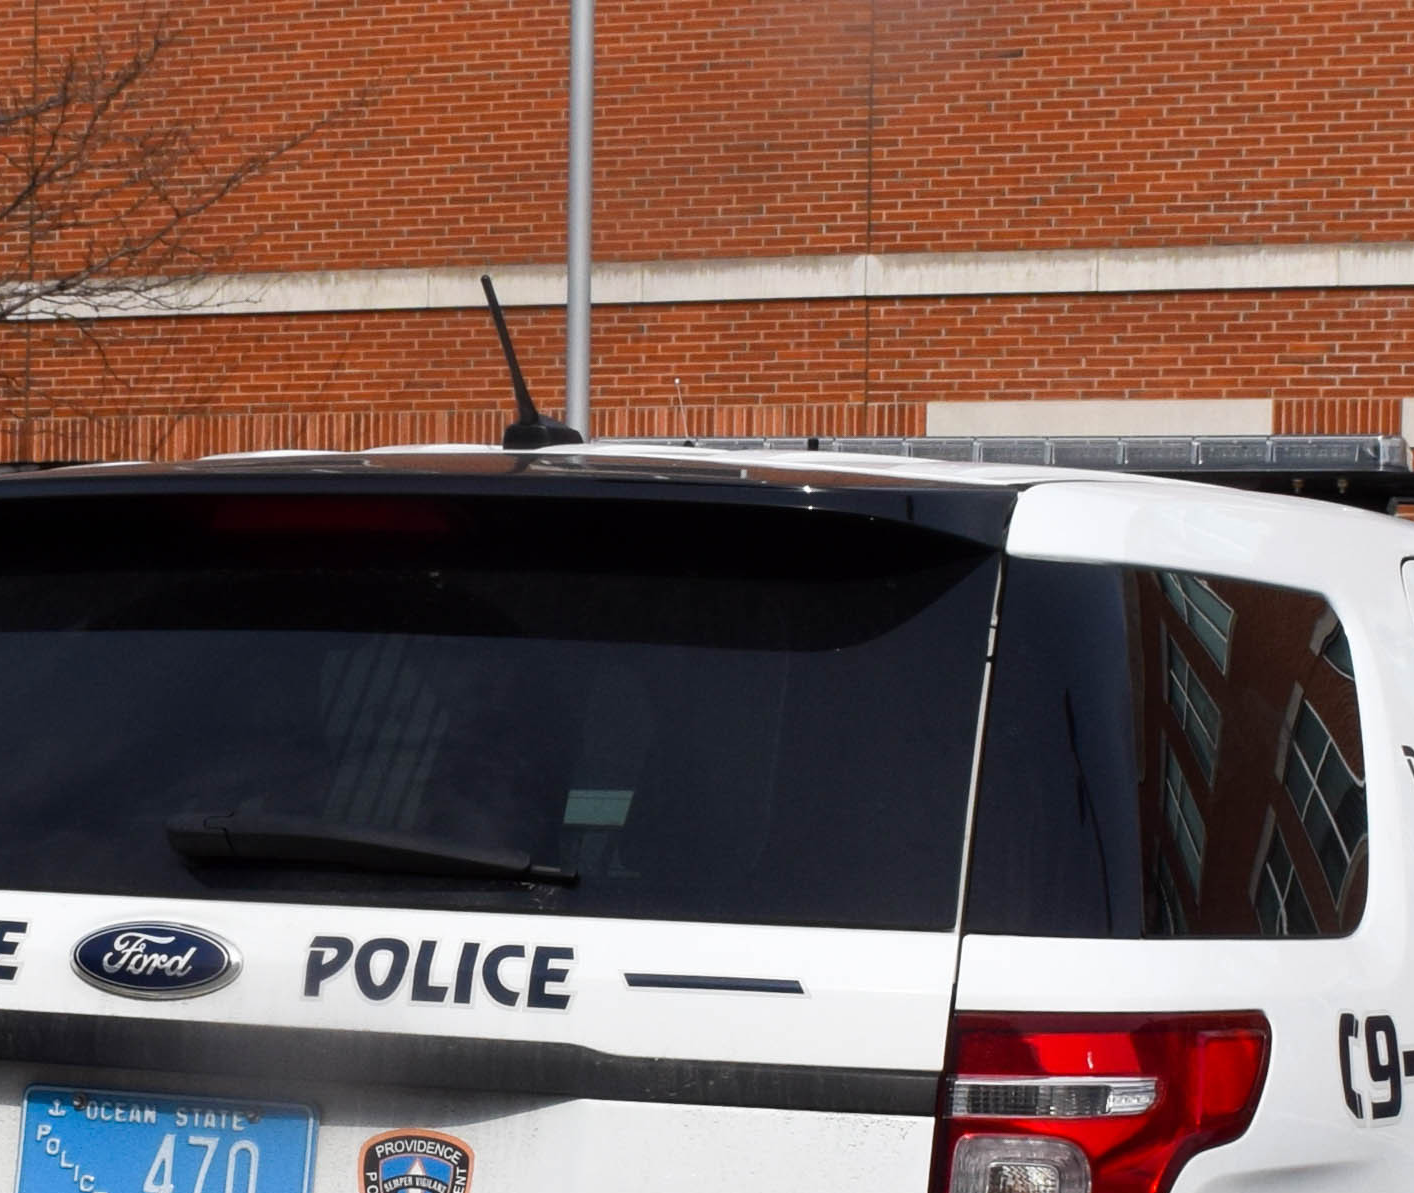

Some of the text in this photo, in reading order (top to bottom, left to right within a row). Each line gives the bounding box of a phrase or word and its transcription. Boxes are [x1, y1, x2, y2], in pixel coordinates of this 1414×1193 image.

[101, 931, 196, 978] Ford
[303, 935, 575, 1010] POLICE
[86, 1102, 246, 1131] OCEAN STATE
[375, 1139, 462, 1165] PROVIDENCE
